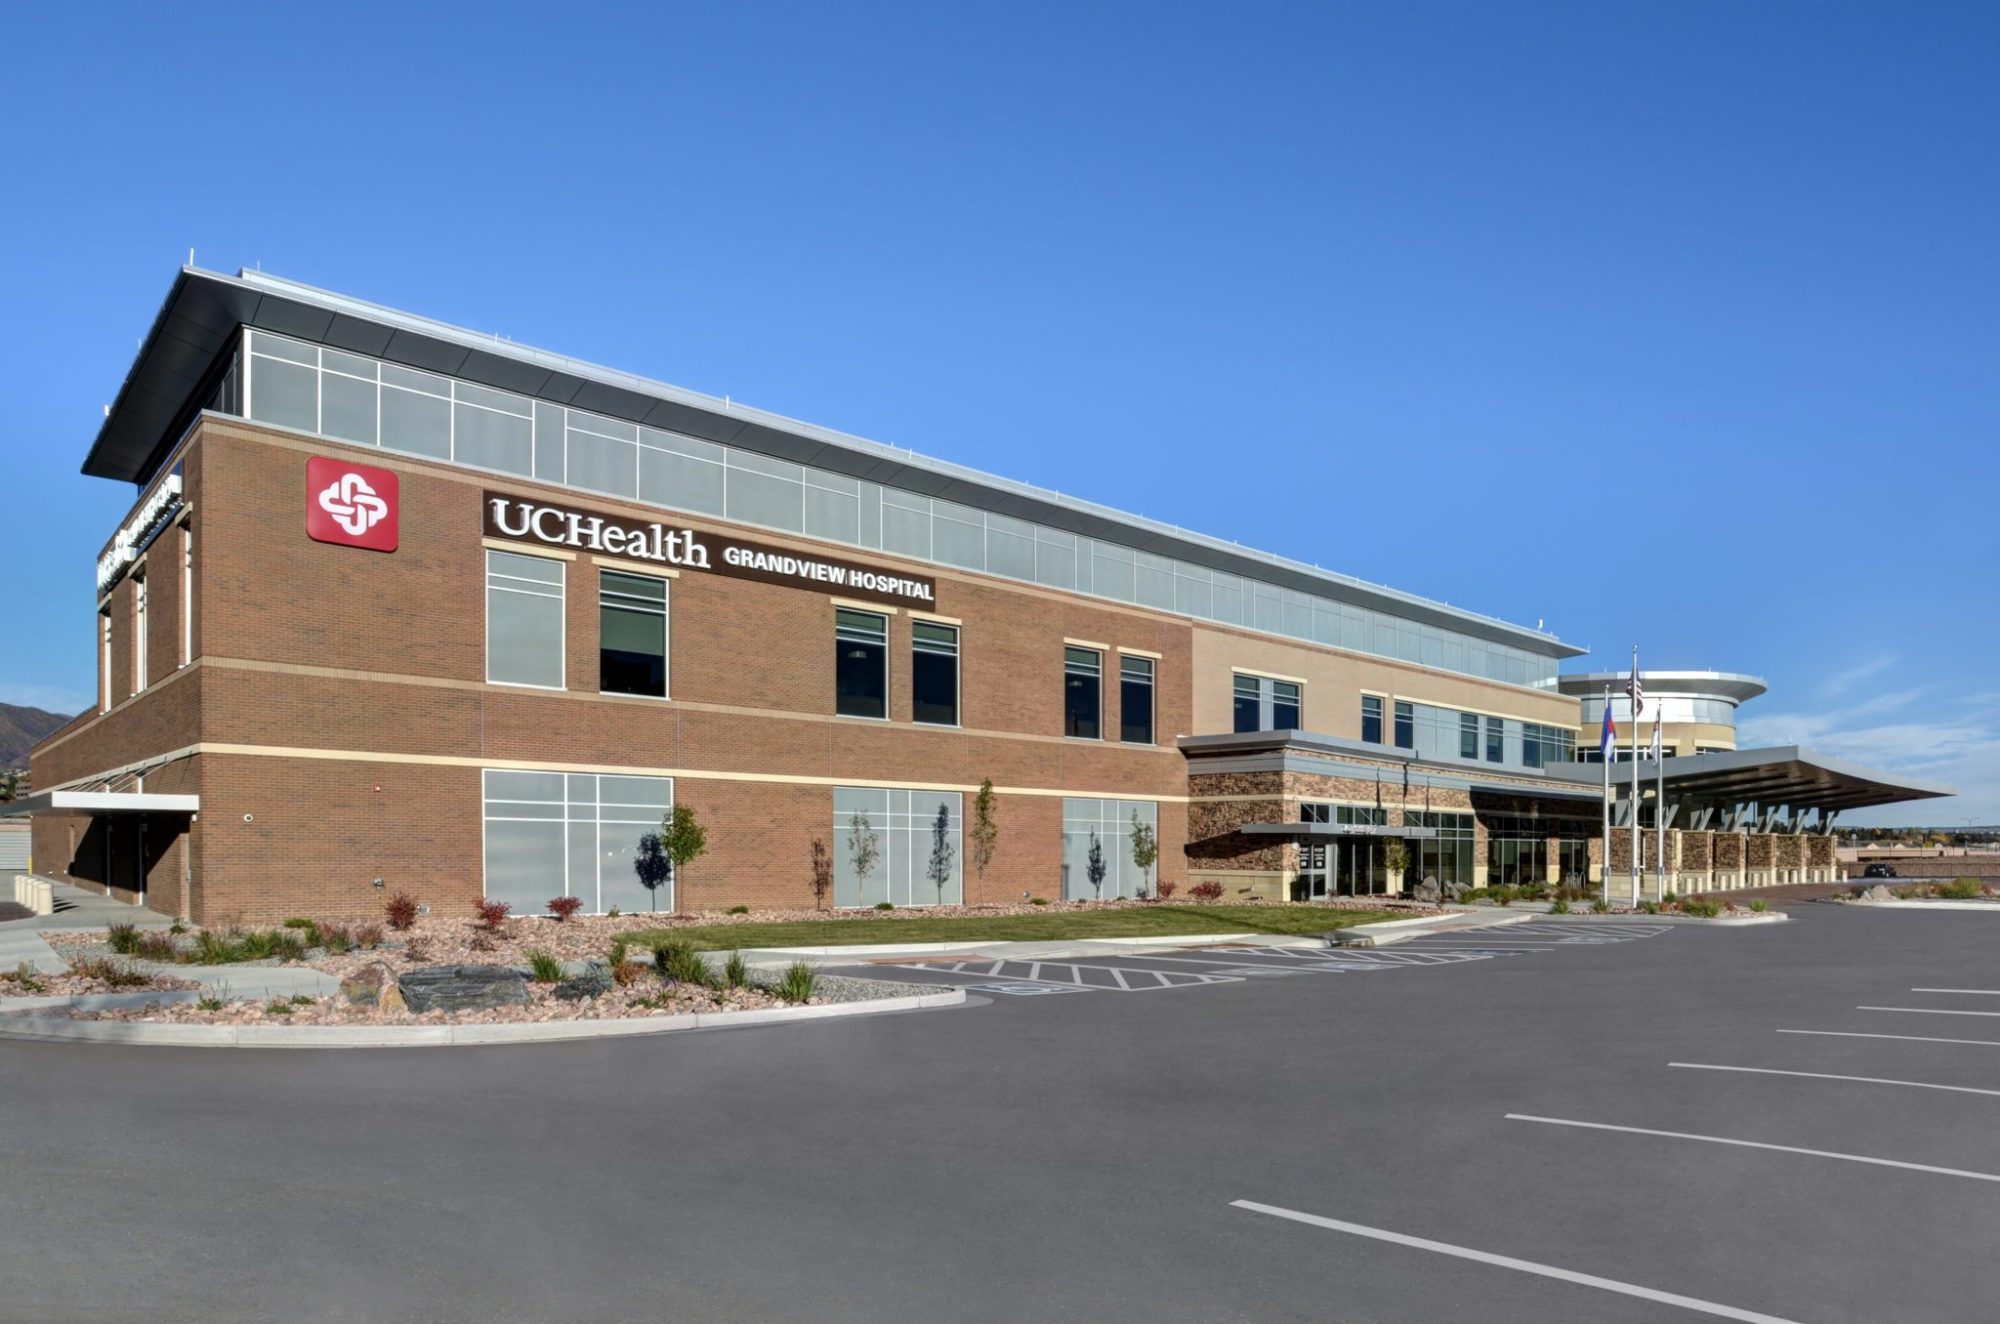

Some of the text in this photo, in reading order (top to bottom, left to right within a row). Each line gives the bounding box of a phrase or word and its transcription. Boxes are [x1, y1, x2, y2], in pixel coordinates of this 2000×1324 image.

[489, 498, 934, 601] UCHealth GRANDVIEW HOSPITAL
